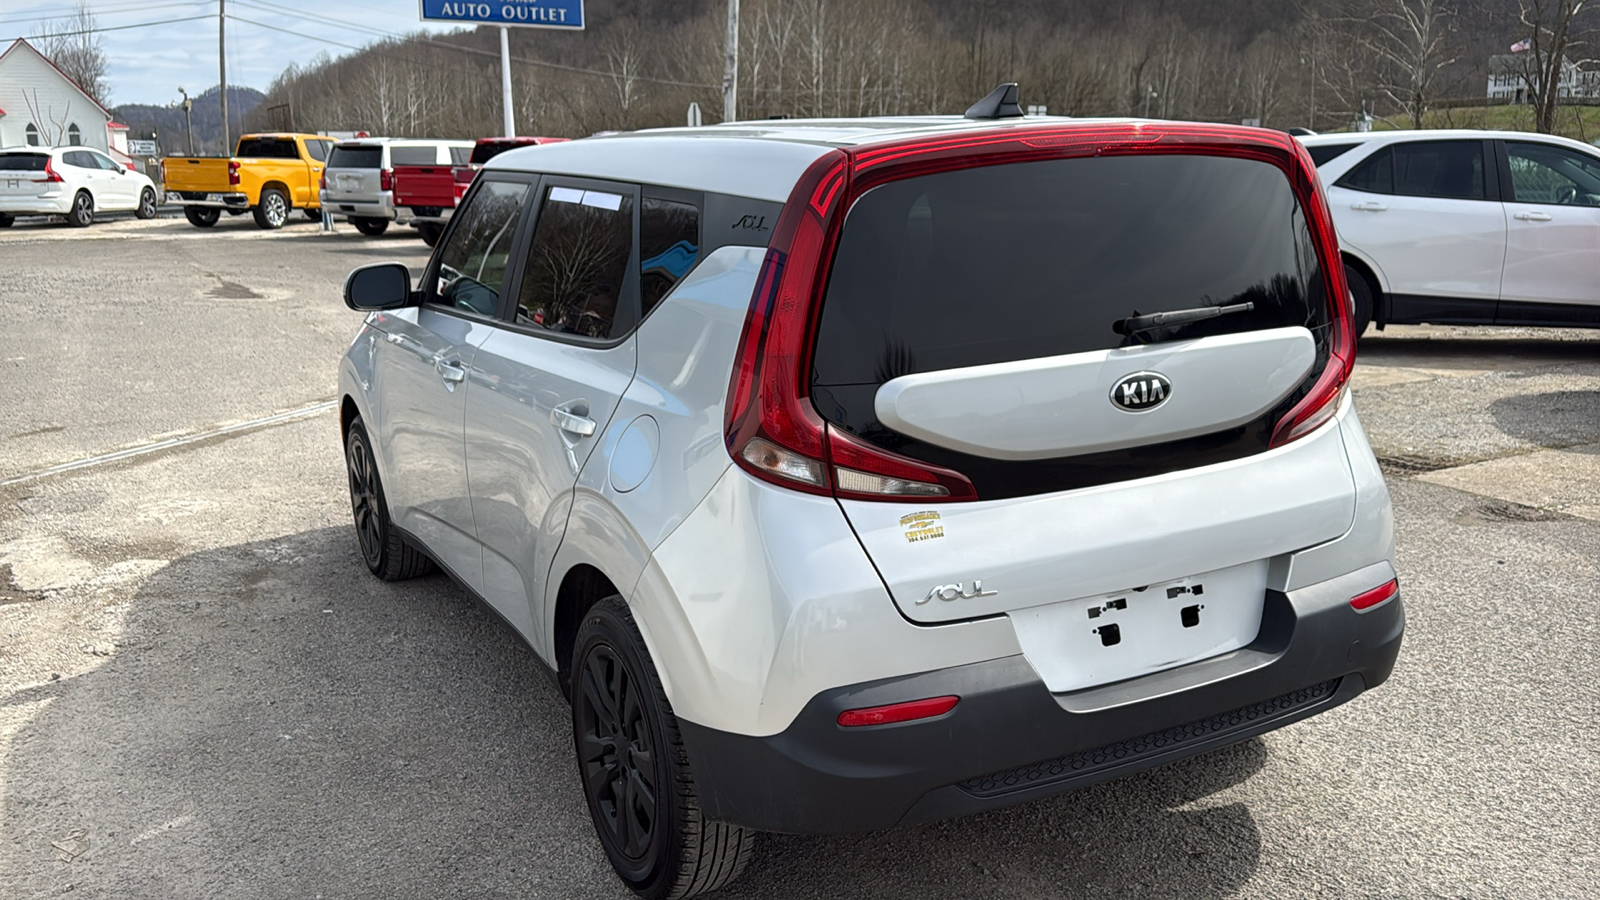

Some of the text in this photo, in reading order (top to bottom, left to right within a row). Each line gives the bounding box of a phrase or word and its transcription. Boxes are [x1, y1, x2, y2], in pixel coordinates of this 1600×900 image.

[442, 2, 567, 22] AUTO OUTLET
[1121, 379, 1165, 405] KIA
[904, 526, 944, 538] CHEVROLET
[915, 580, 998, 606] SOUL
